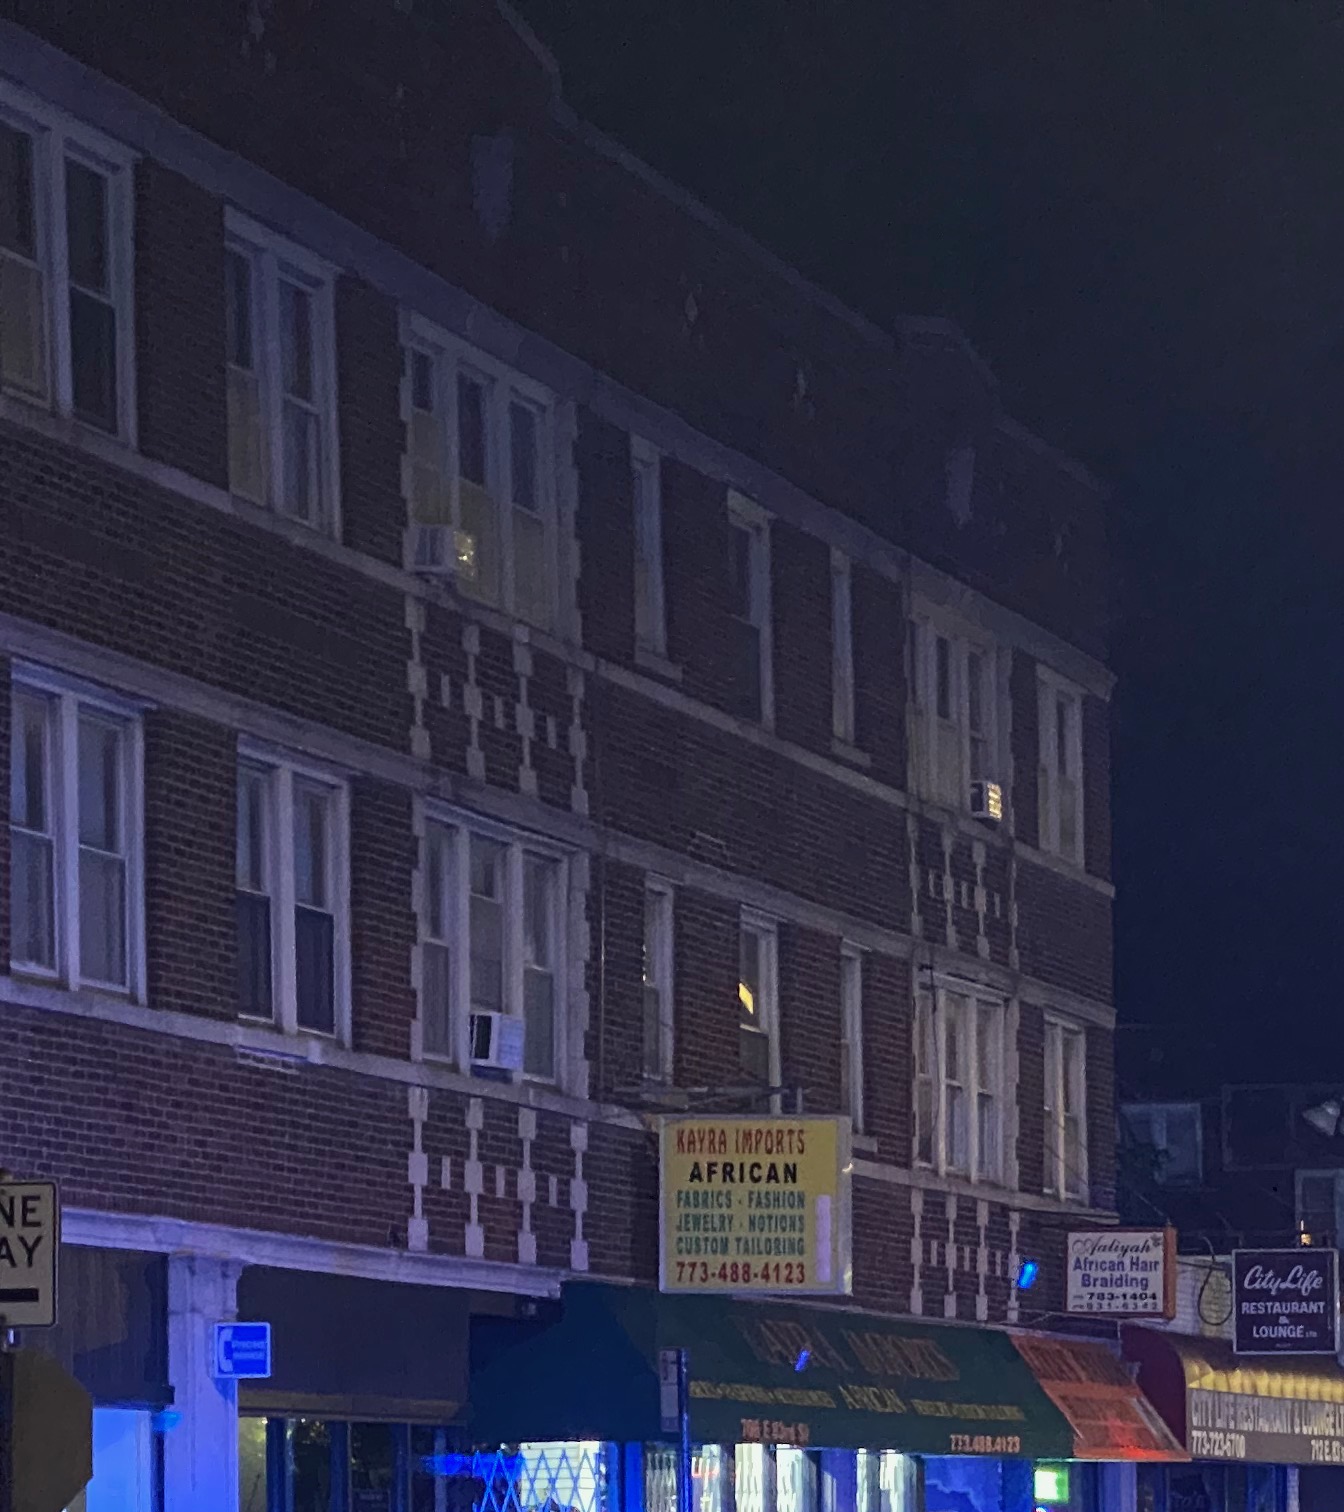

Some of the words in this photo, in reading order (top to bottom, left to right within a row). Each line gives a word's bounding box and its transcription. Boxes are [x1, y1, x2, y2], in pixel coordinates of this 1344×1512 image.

[676, 1129, 727, 1154] KAYRA
[735, 1129, 805, 1154] IMPORTS
[689, 1162, 798, 1183] AFRICAN
[677, 1190, 732, 1209] FABRICS
[748, 1190, 805, 1209] FASHION
[0, 1195, 42, 1228] NE
[677, 1214, 734, 1232] JEWELRY
[748, 1214, 805, 1233] NOTIONS
[0, 1235, 43, 1269] AY
[677, 1237, 729, 1255] CUSTOM
[736, 1237, 805, 1256] TAILORING
[676, 1262, 806, 1283] 773-488-4123
[1073, 1256, 1125, 1271] African
[1130, 1256, 1159, 1271] Hair
[1081, 1273, 1149, 1290] Braiding
[1244, 1265, 1281, 1296] City
[1279, 1265, 1323, 1296] Life
[1241, 1301, 1325, 1314] RESTAURANT
[1253, 1325, 1304, 1338] LOUNGE
